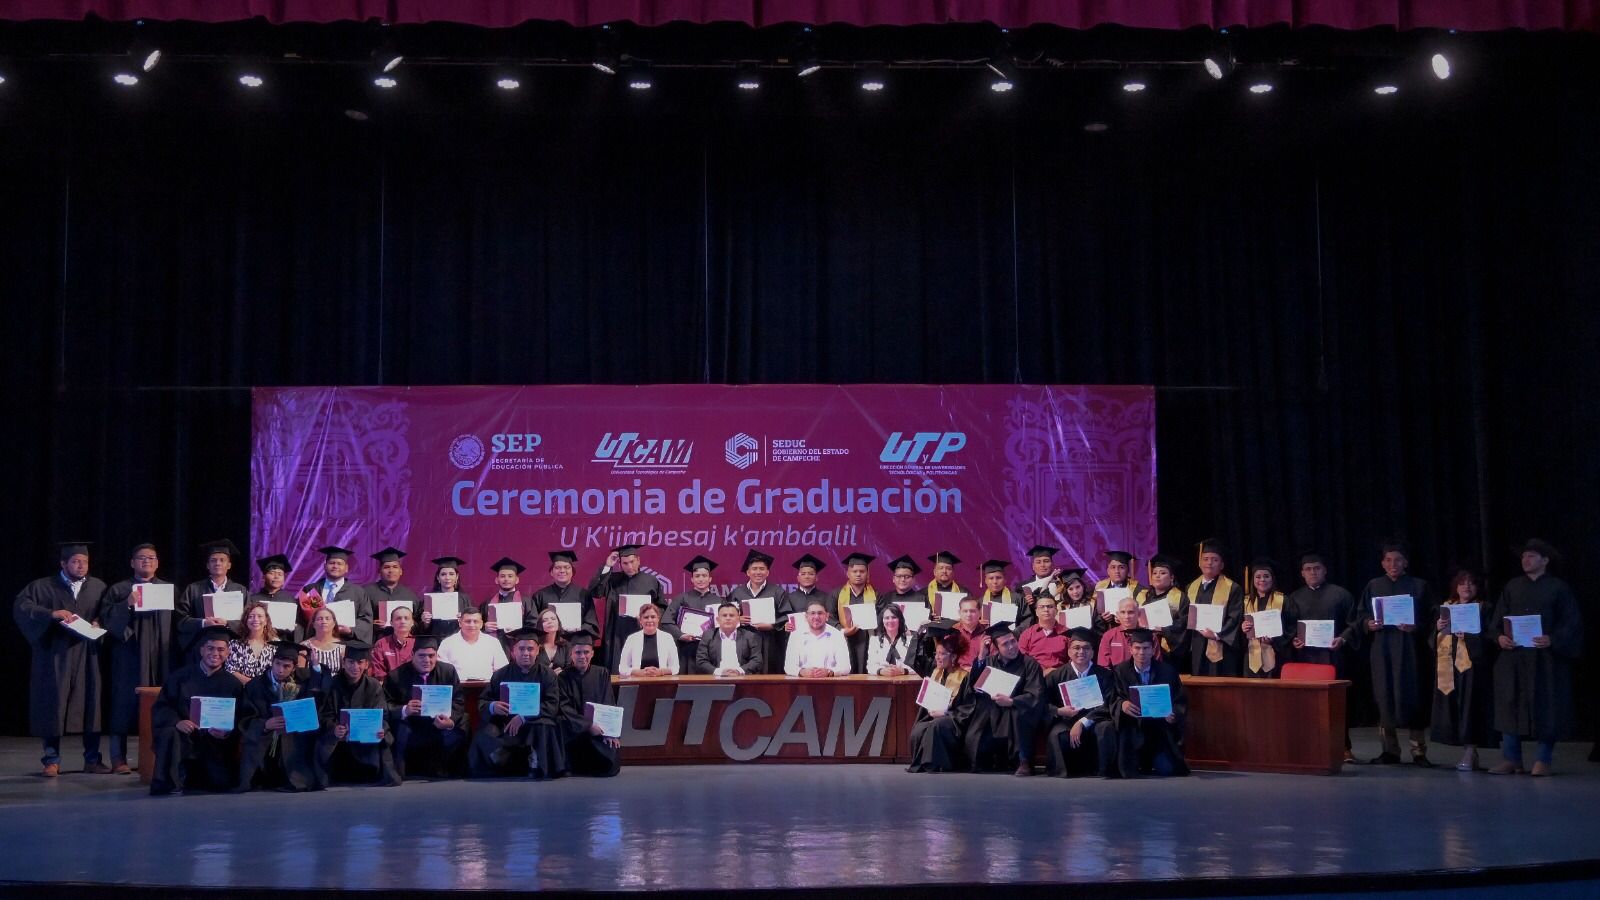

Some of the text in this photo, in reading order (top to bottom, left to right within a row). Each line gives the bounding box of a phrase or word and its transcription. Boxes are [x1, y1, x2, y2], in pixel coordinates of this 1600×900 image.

[491, 433, 542, 453] SEP
[772, 439, 806, 448] SEDUC
[451, 478, 962, 516] Ceremonia de Graduación
[560, 526, 578, 548] U
[617, 684, 893, 761] UTCAM
